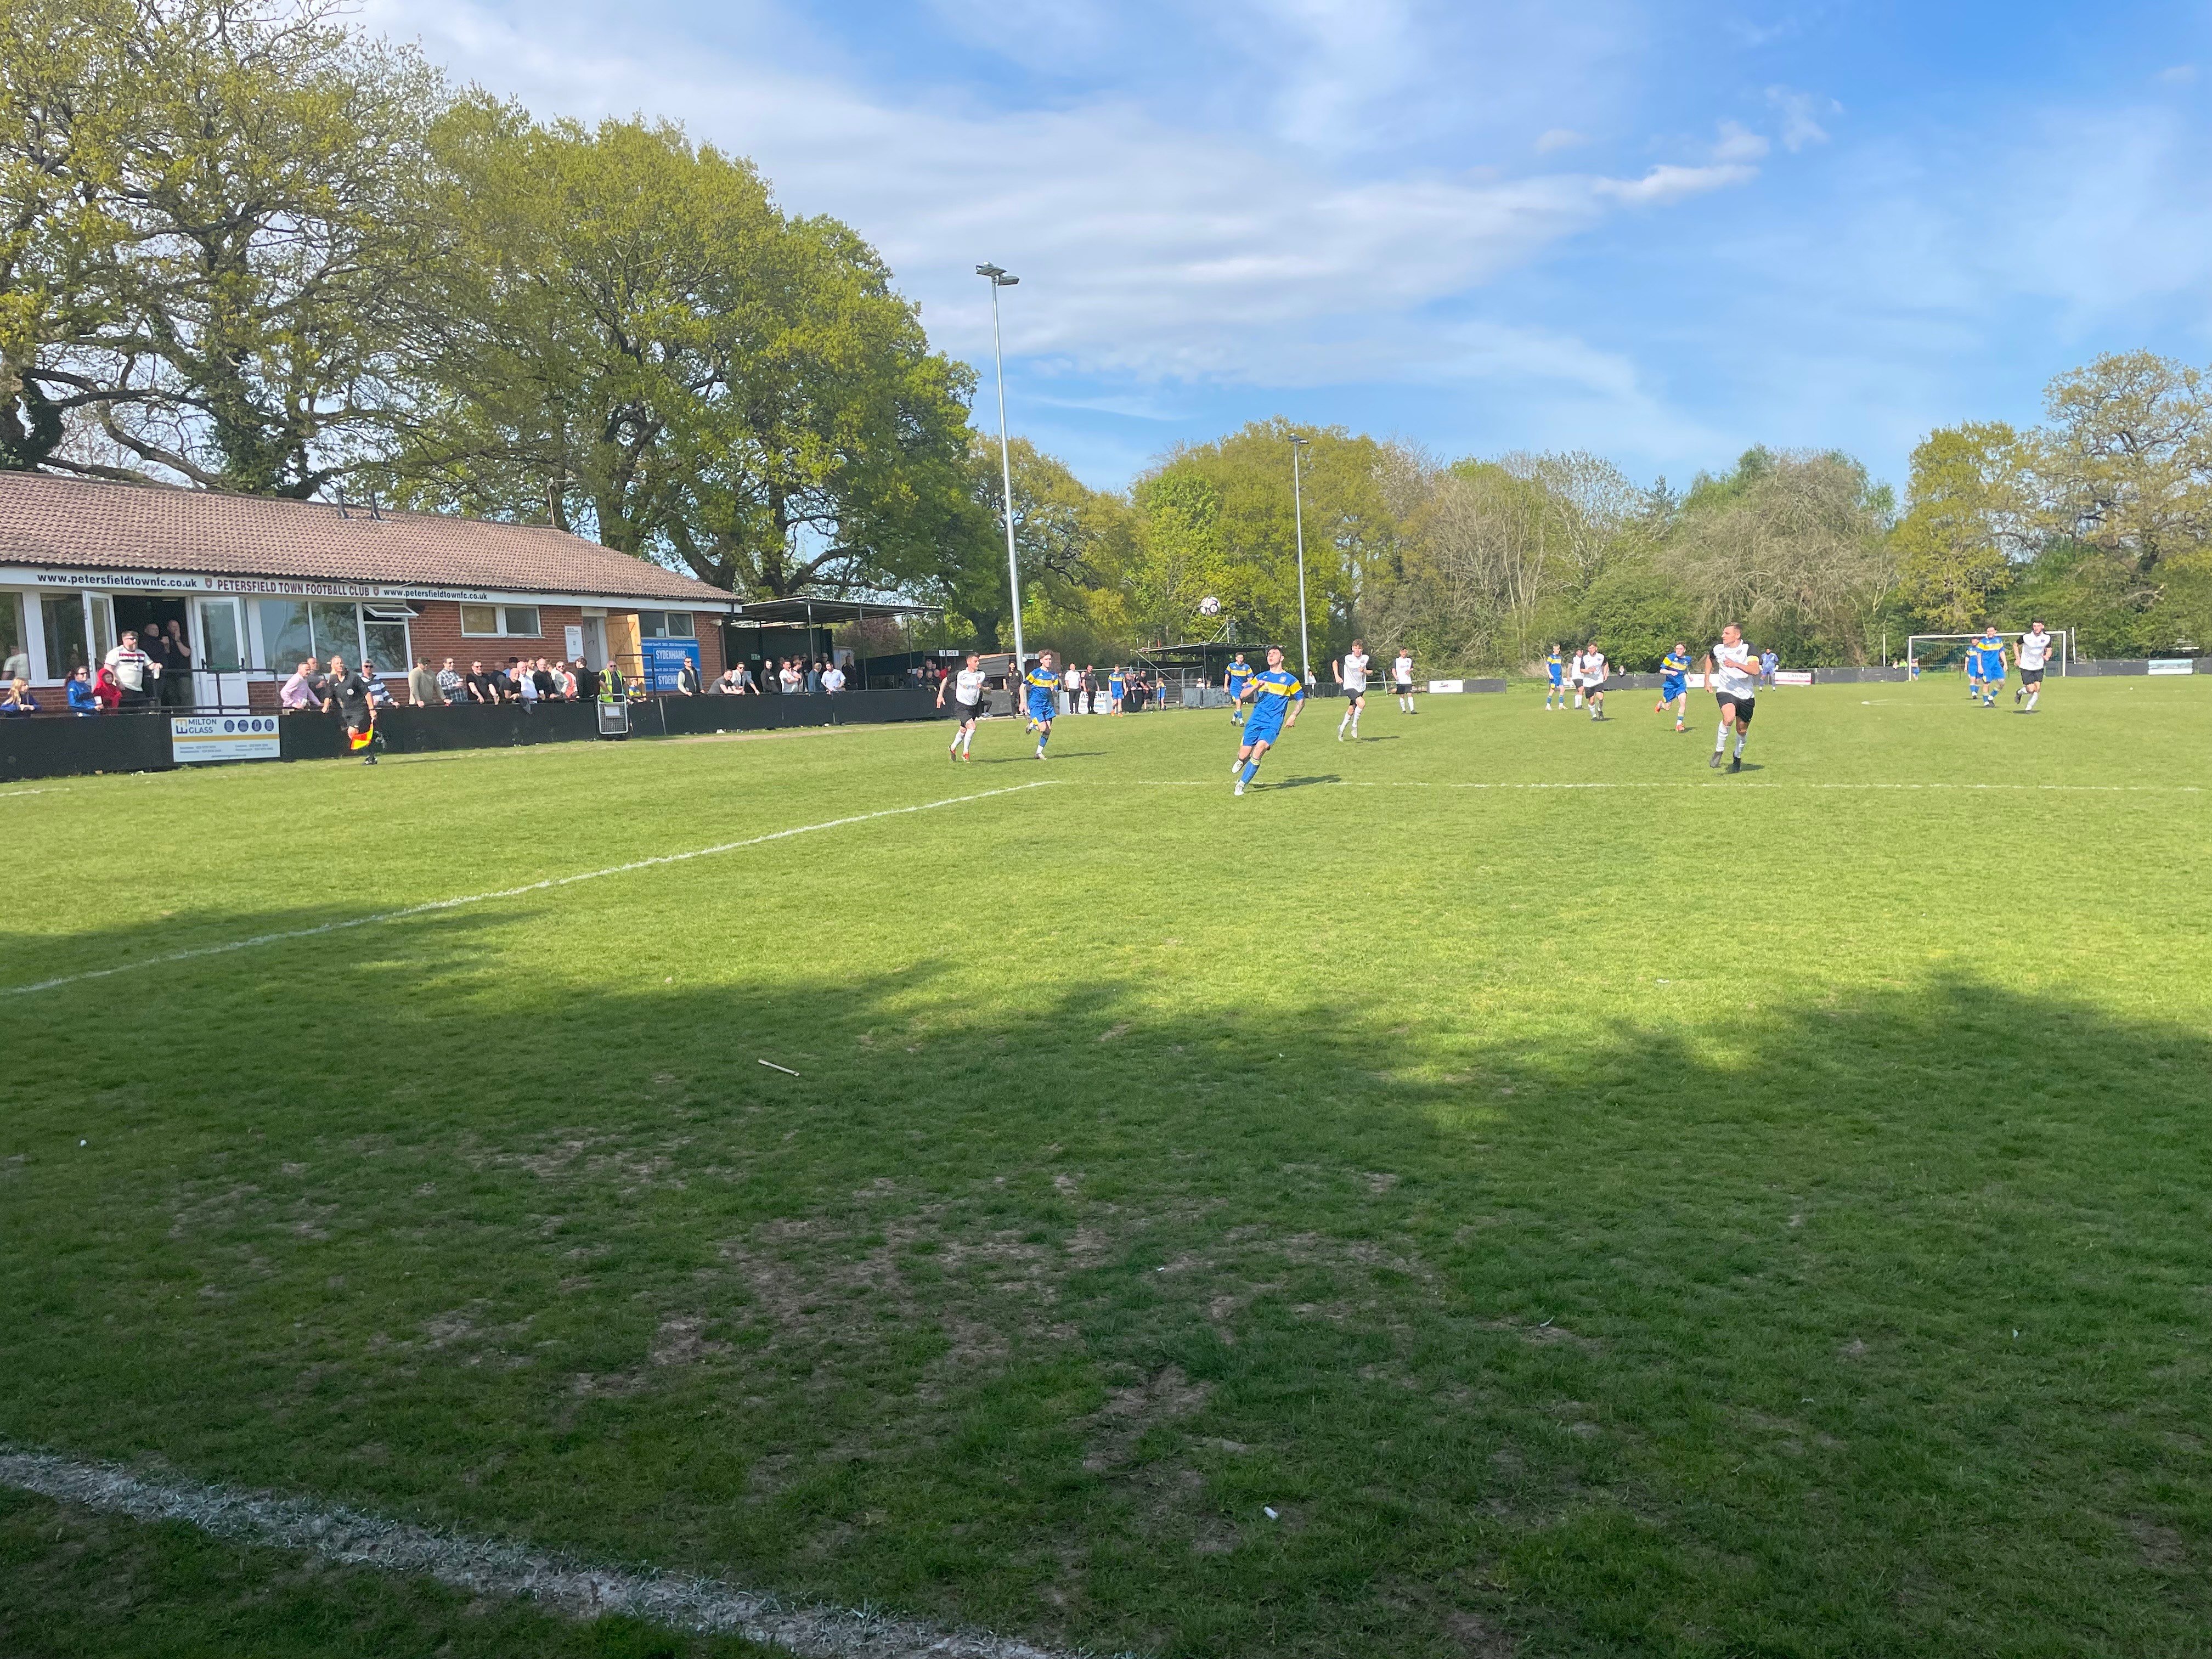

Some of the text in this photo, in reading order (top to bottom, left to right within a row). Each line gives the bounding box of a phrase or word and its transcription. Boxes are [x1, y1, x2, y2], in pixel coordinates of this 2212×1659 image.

[37, 574, 197, 588] www.petersfieldtownfc.co.uk
[217, 579, 370, 596] PETERSFIELD TOWN FOOTBALL CLUB
[384, 589, 487, 600] www.petersfieldtownfc.co.uk
[656, 650, 686, 659] SYDENHAMS
[658, 675, 678, 685] SYDENH
